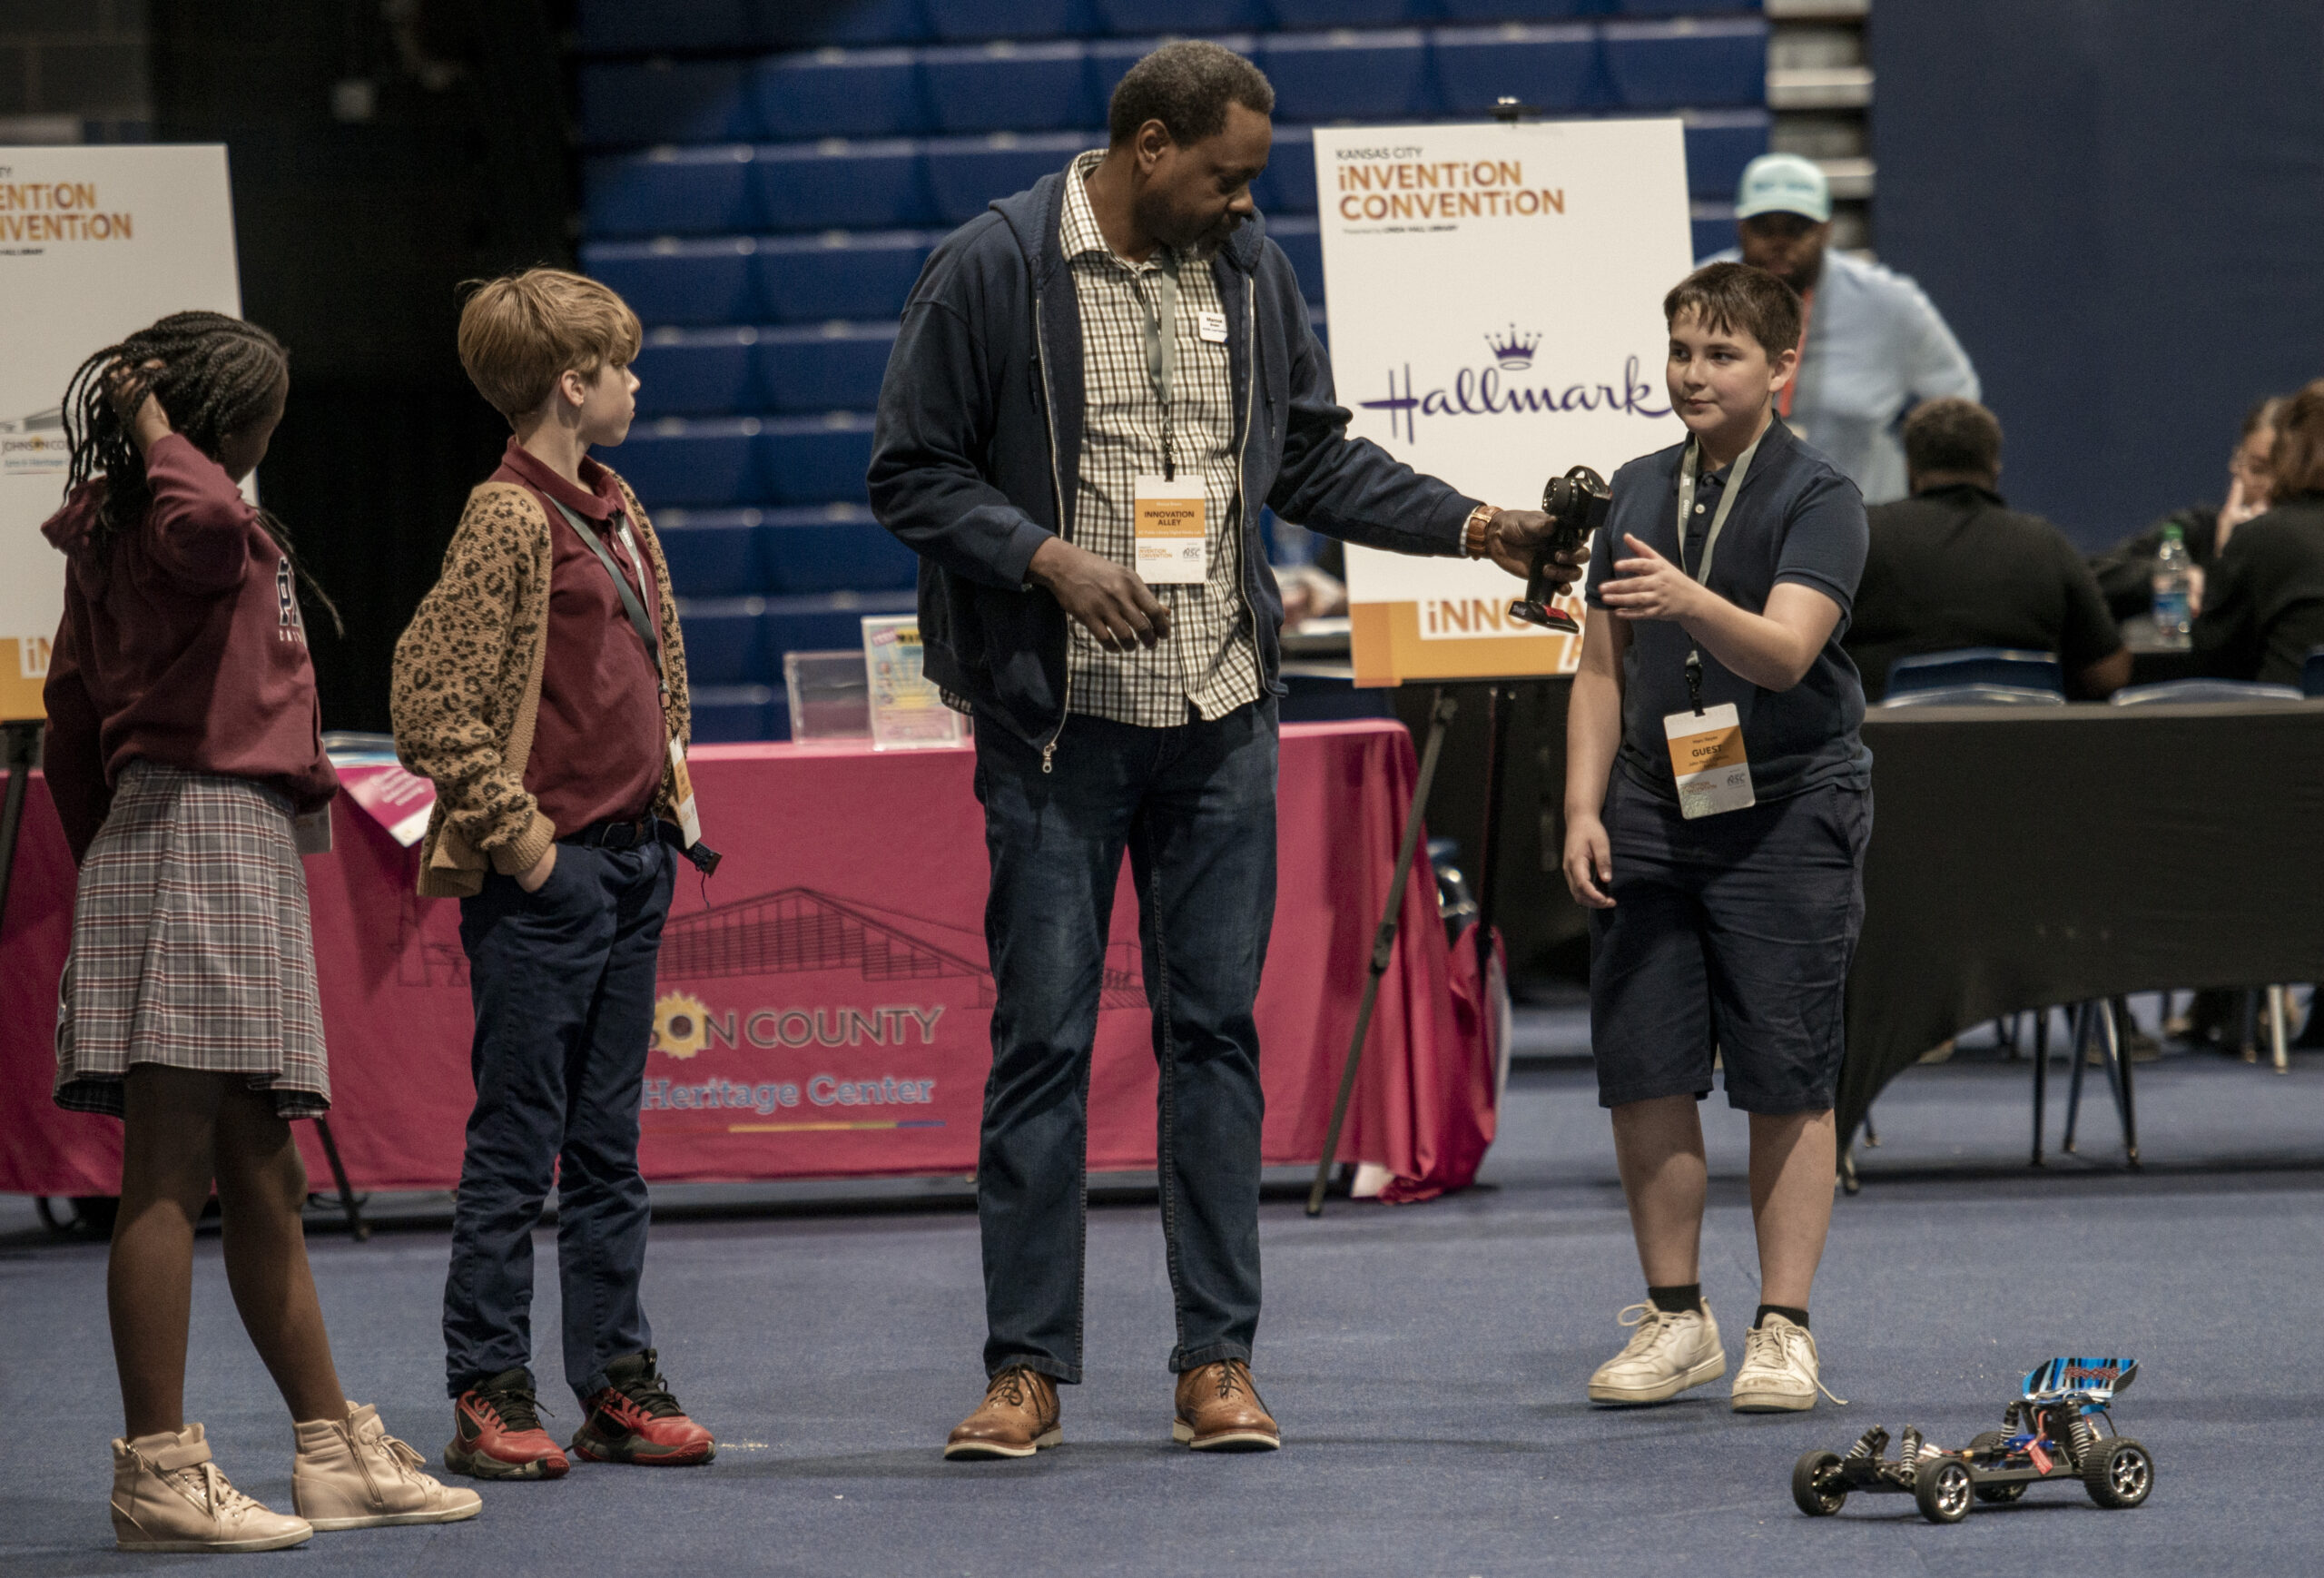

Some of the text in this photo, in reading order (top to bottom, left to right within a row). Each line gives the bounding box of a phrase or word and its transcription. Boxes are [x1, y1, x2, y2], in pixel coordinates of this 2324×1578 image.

[1336, 147, 1423, 160] KANSAS CITY
[0, 212, 133, 242] VENTiON
[1359, 355, 1673, 445] Hallmark
[1144, 510, 1195, 518] INNOVATION
[1691, 745, 1723, 758] GUEST
[746, 1007, 945, 1049] COUNTY
[641, 1074, 934, 1115] Heritage Center
